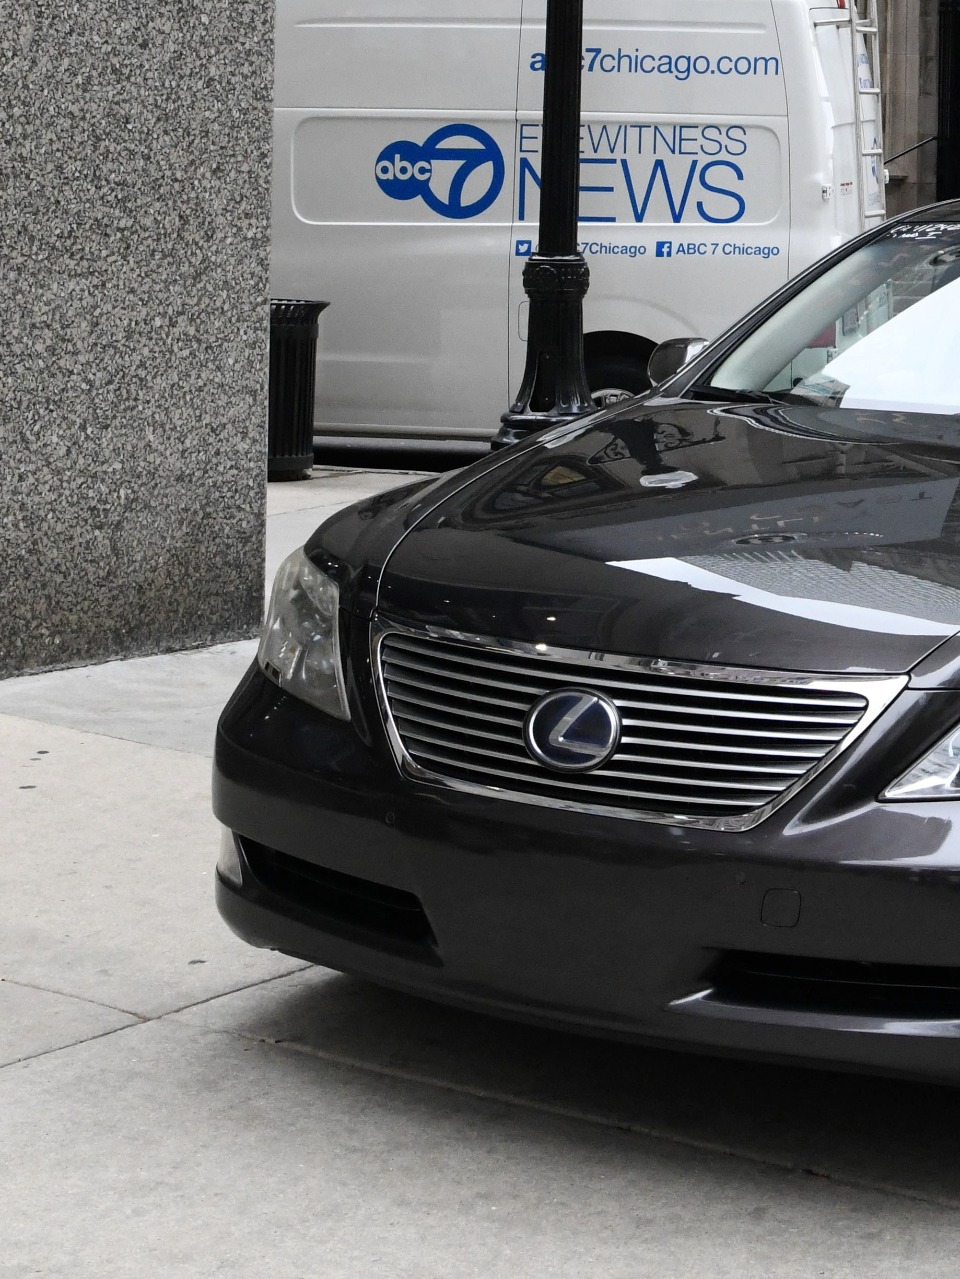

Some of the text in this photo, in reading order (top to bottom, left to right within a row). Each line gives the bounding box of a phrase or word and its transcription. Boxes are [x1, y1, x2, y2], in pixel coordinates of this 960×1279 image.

[529, 47, 779, 81] a7chicago.com
[519, 123, 747, 156] EWITNESS
[535, 242, 647, 258] 7Chicago
[676, 243, 707, 256] ABC
[711, 243, 719, 255] 7
[722, 243, 780, 259] Chicago
